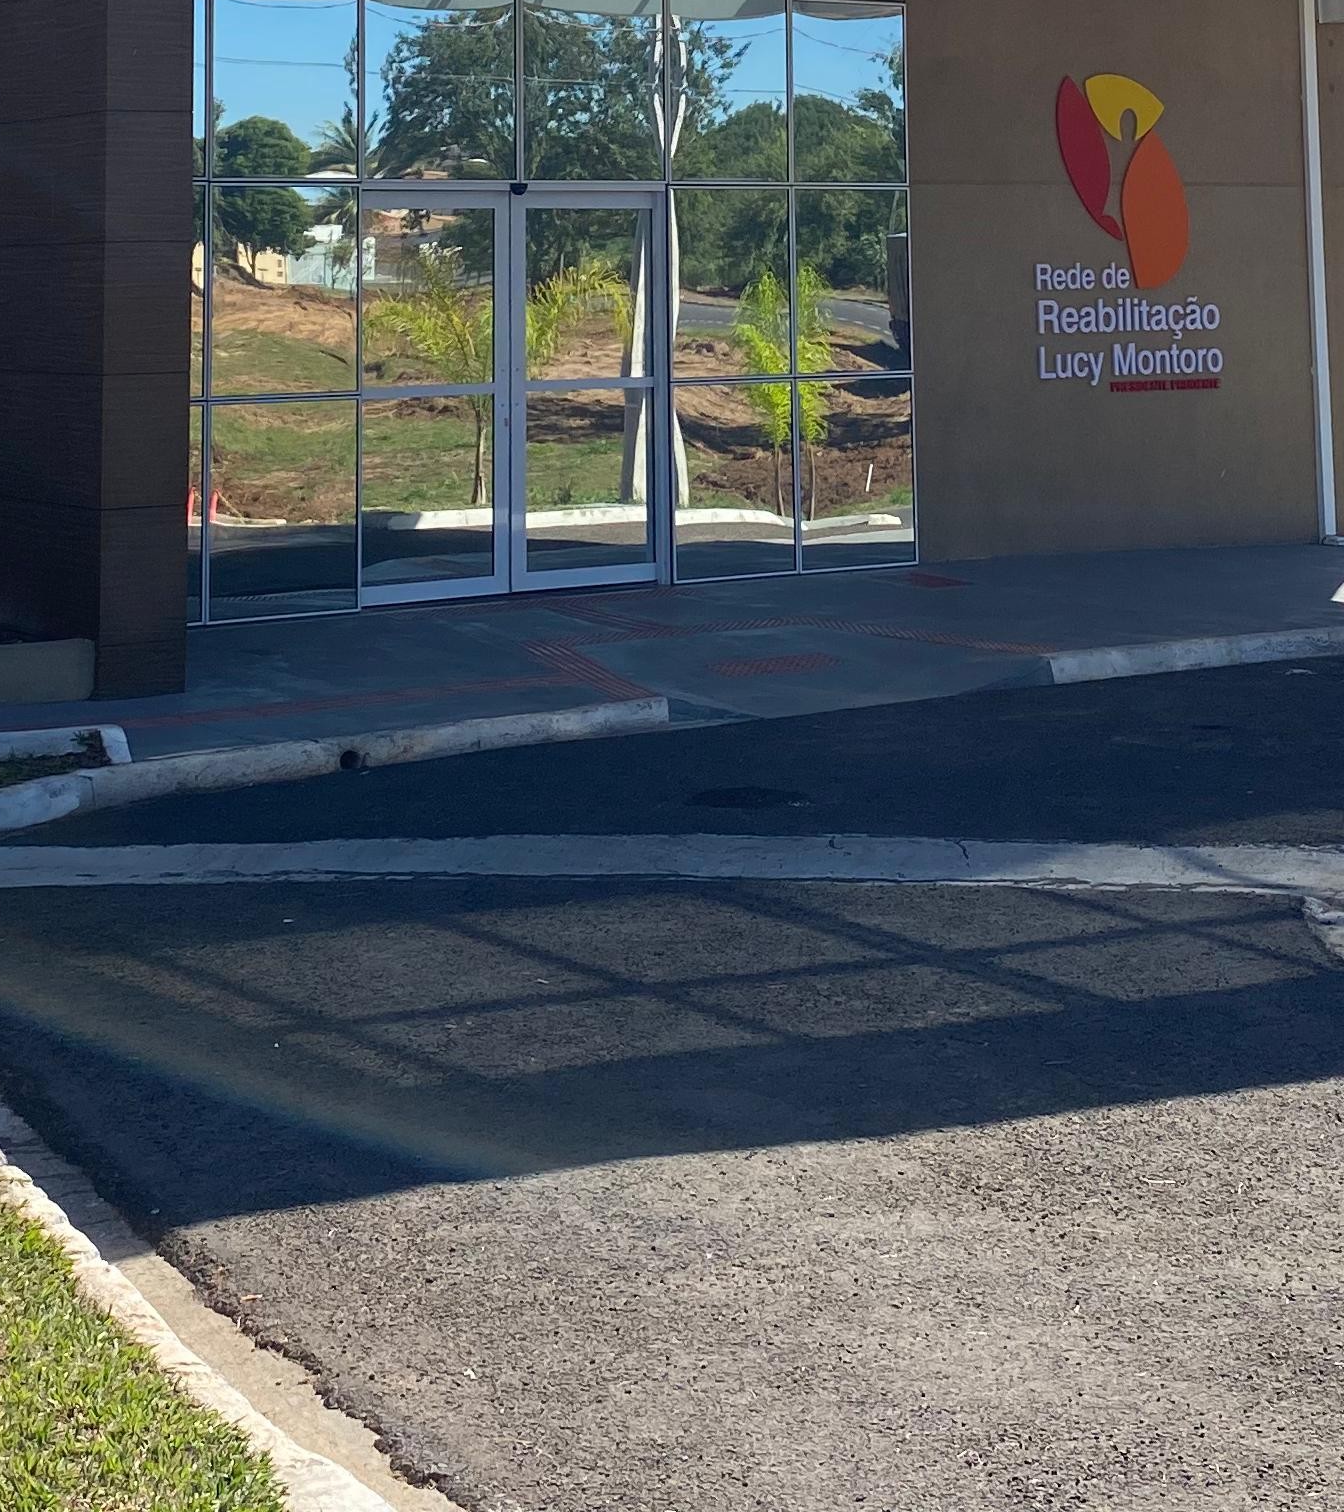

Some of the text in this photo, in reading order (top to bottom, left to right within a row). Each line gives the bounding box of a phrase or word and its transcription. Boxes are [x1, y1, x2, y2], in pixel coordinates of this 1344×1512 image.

[1035, 262, 1131, 291] Rede de
[1037, 296, 1221, 340] Reabilitação
[1038, 342, 1224, 386] Lucy Montoro
